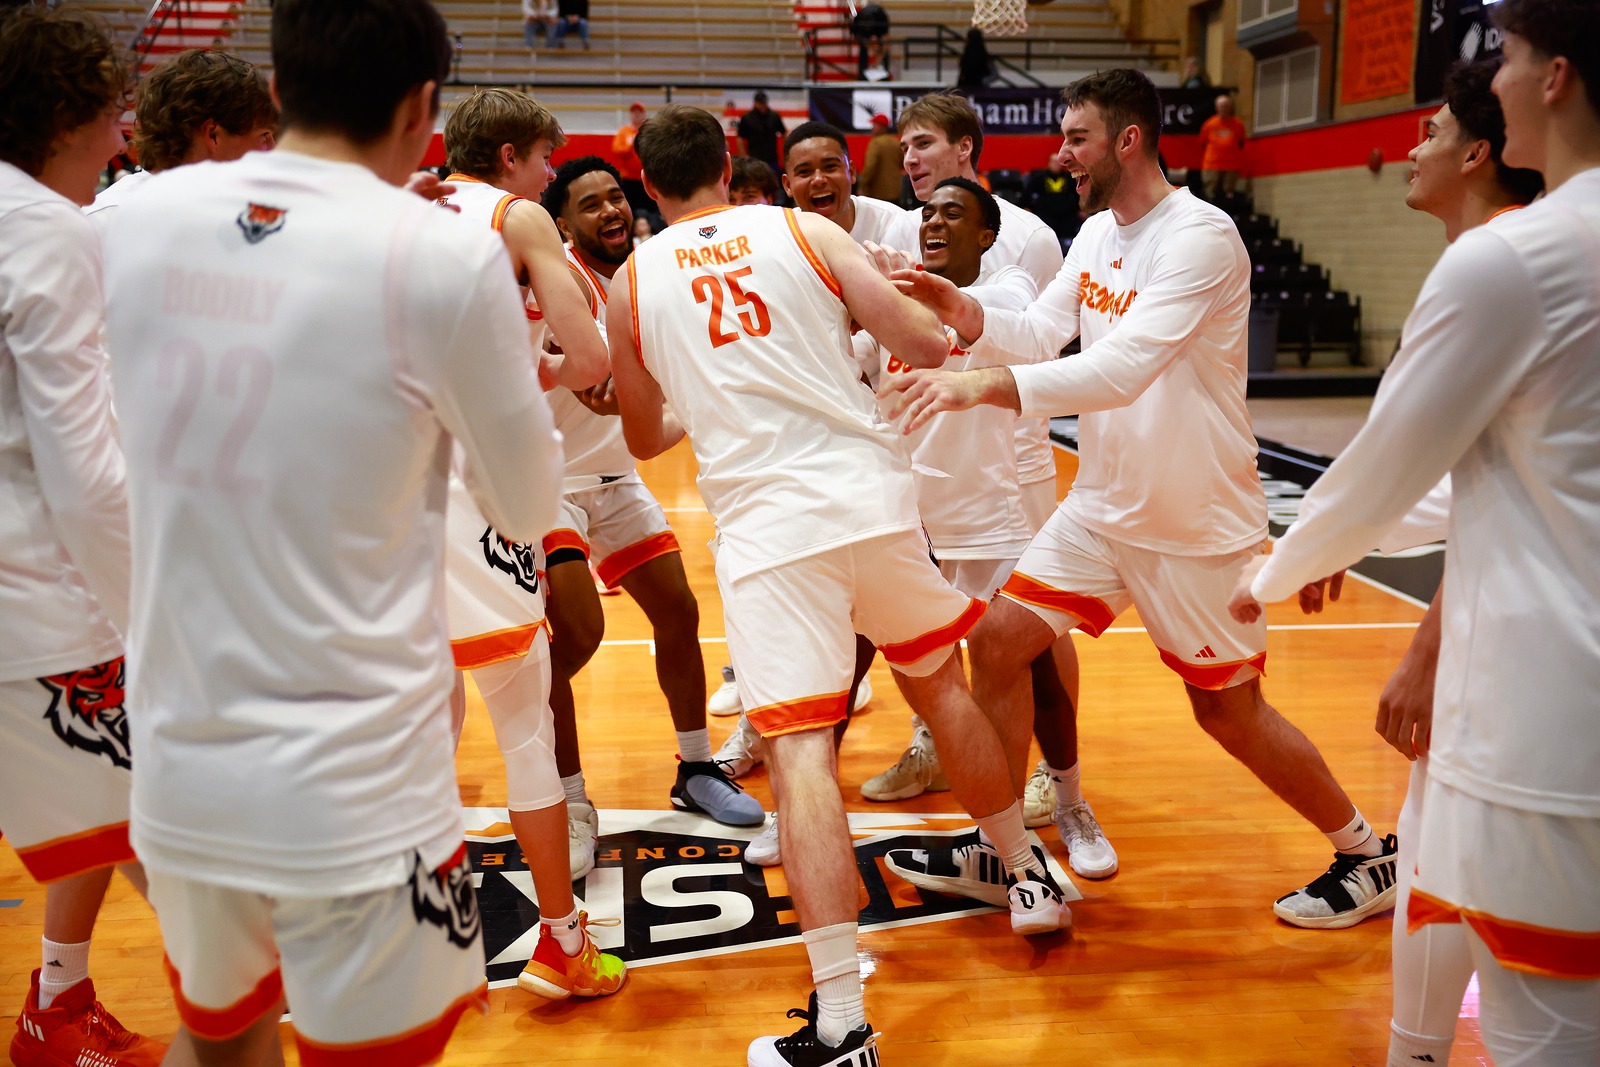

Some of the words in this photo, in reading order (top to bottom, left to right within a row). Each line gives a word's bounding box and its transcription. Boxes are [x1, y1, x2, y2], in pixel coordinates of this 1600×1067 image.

[674, 235, 752, 270] PARKER
[691, 265, 772, 349] 25
[154, 337, 275, 497] 22
